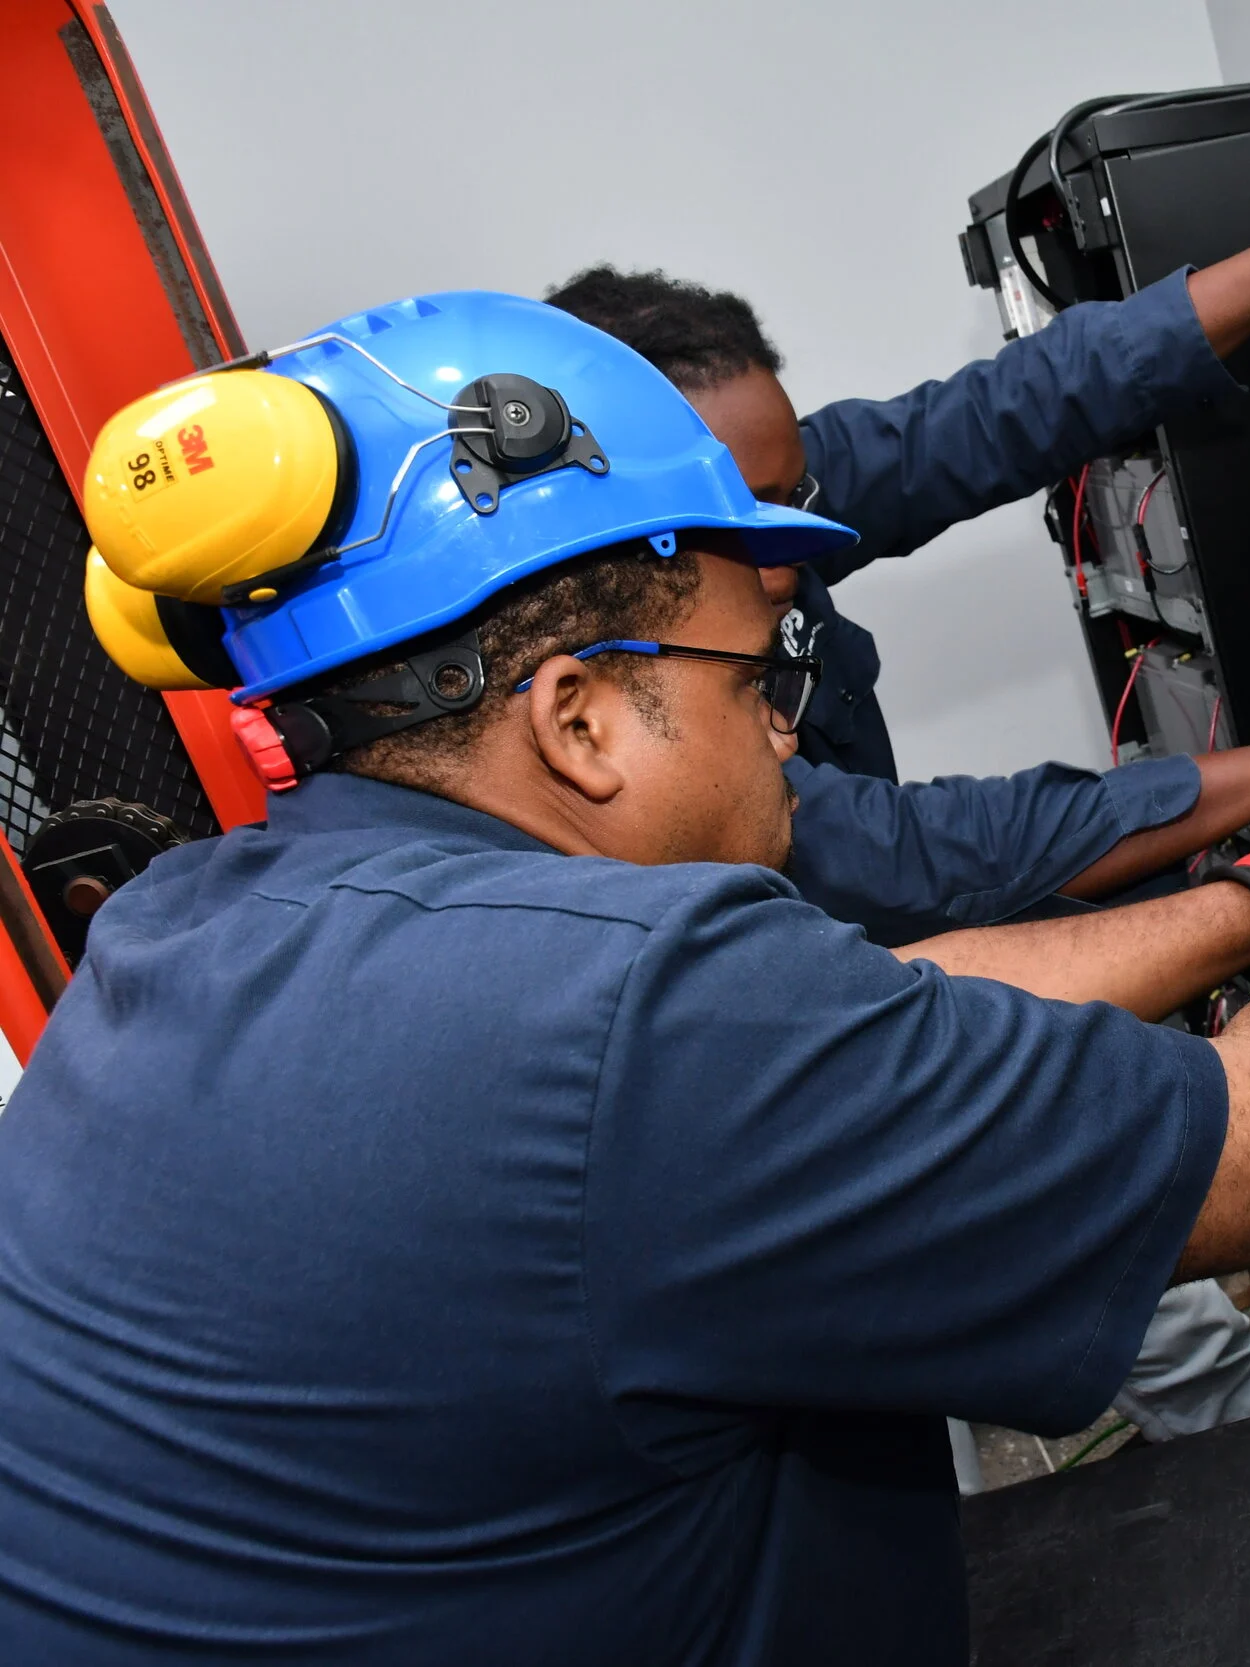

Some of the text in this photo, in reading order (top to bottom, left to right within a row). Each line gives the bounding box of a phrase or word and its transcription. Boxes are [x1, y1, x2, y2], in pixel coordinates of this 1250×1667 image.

[155, 440, 175, 482] OPTIME
[177, 424, 215, 476] 3M
[128, 452, 156, 491] 98
